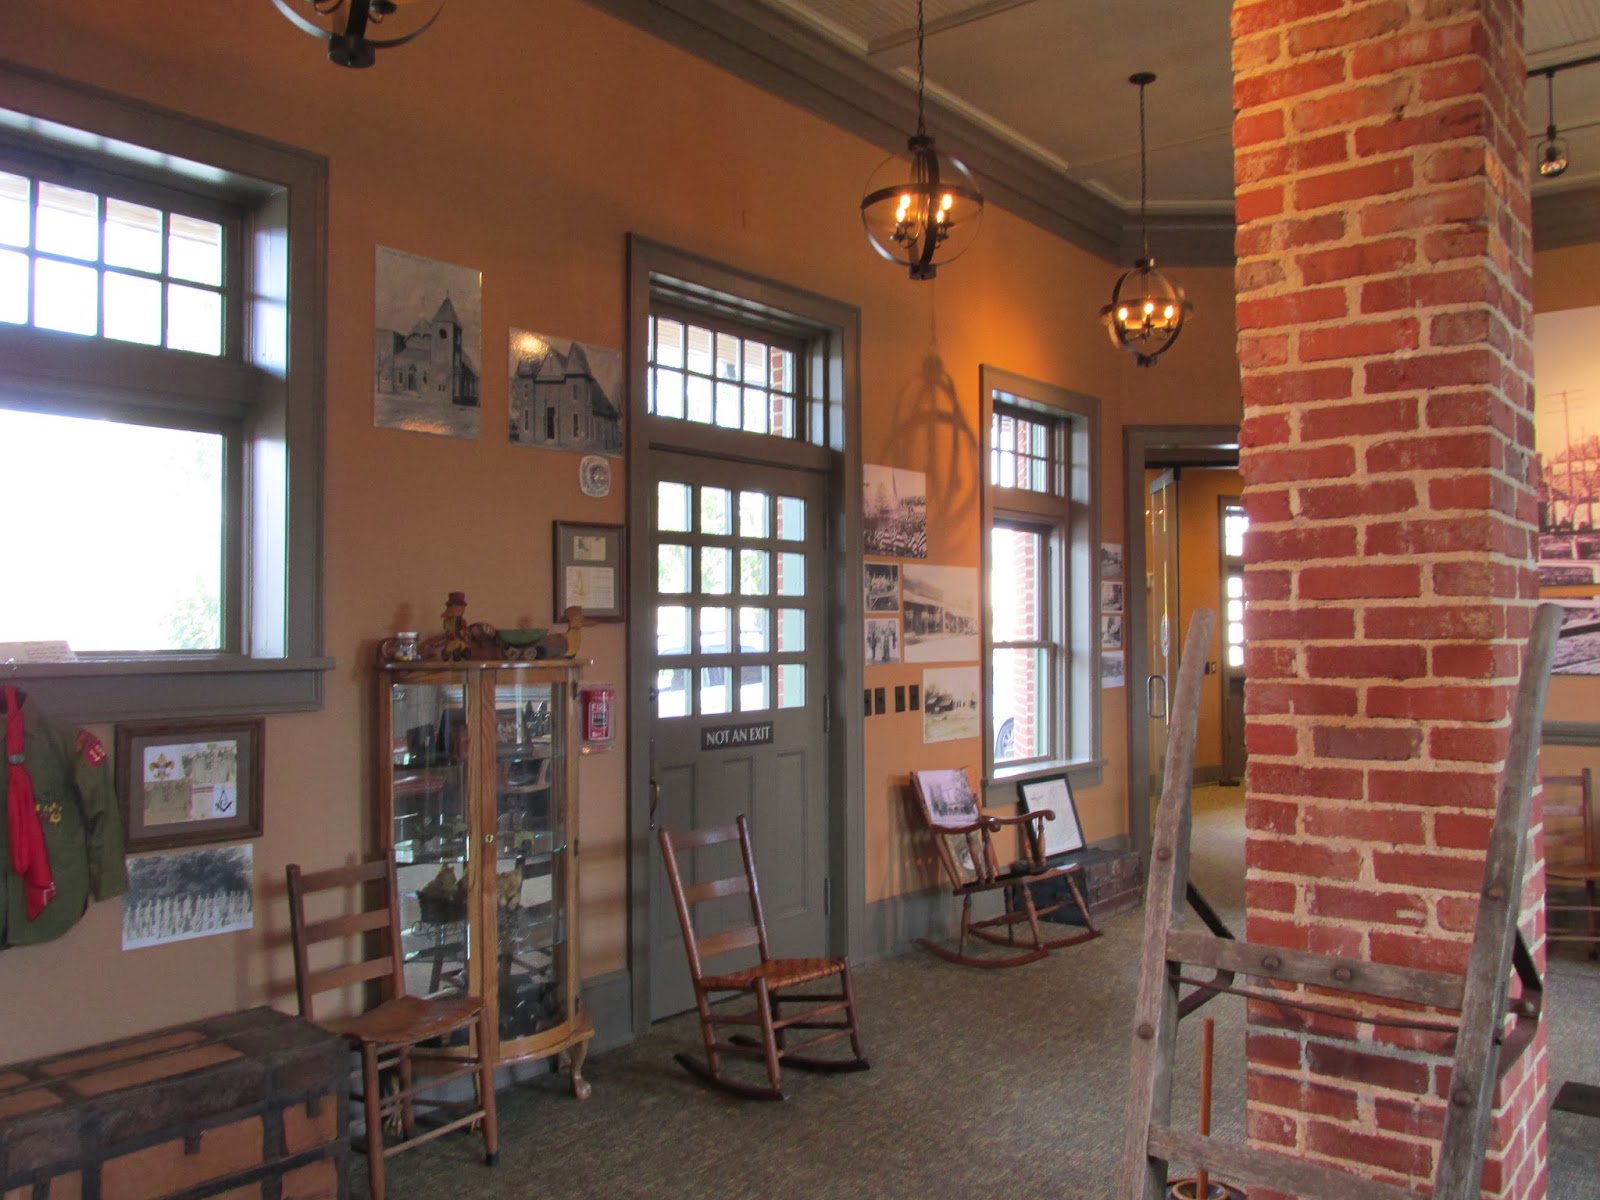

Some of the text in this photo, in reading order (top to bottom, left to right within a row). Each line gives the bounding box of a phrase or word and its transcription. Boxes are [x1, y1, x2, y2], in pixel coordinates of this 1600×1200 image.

[706, 726, 771, 746] NOT AN EXIT
